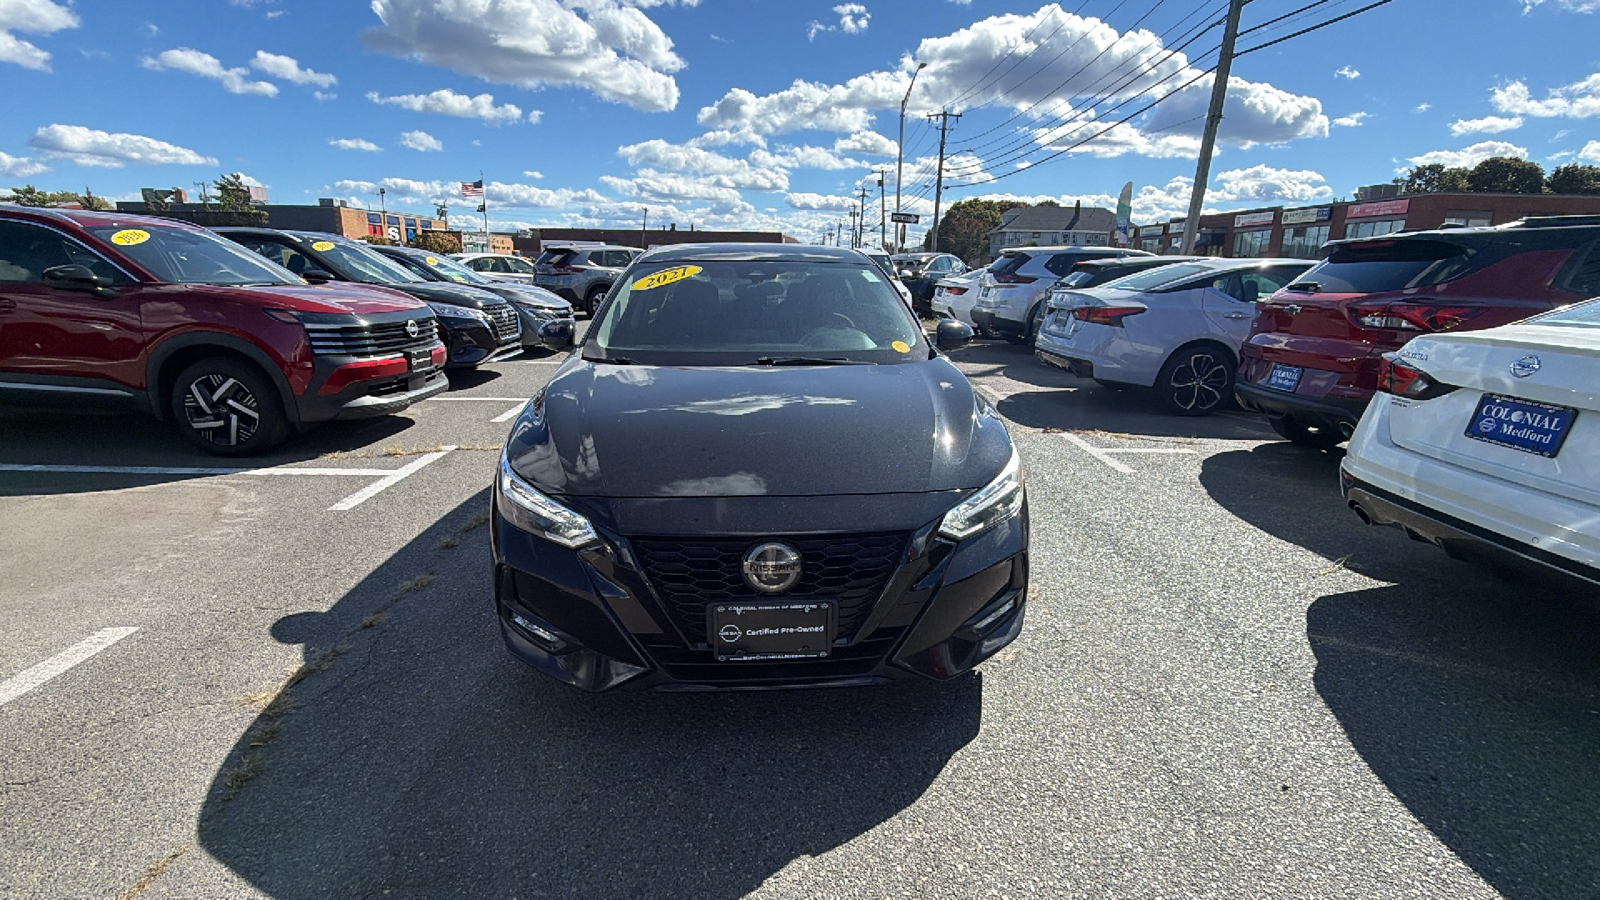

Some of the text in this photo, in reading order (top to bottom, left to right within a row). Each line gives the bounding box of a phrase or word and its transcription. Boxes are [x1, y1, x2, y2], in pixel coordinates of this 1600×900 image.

[646, 267, 688, 287] 2021
[1482, 404, 1562, 431] COLONIAL
[1500, 422, 1553, 444] Medford
[750, 563, 796, 572] NISSAN
[746, 625, 824, 636] Certified Pre-Owned
